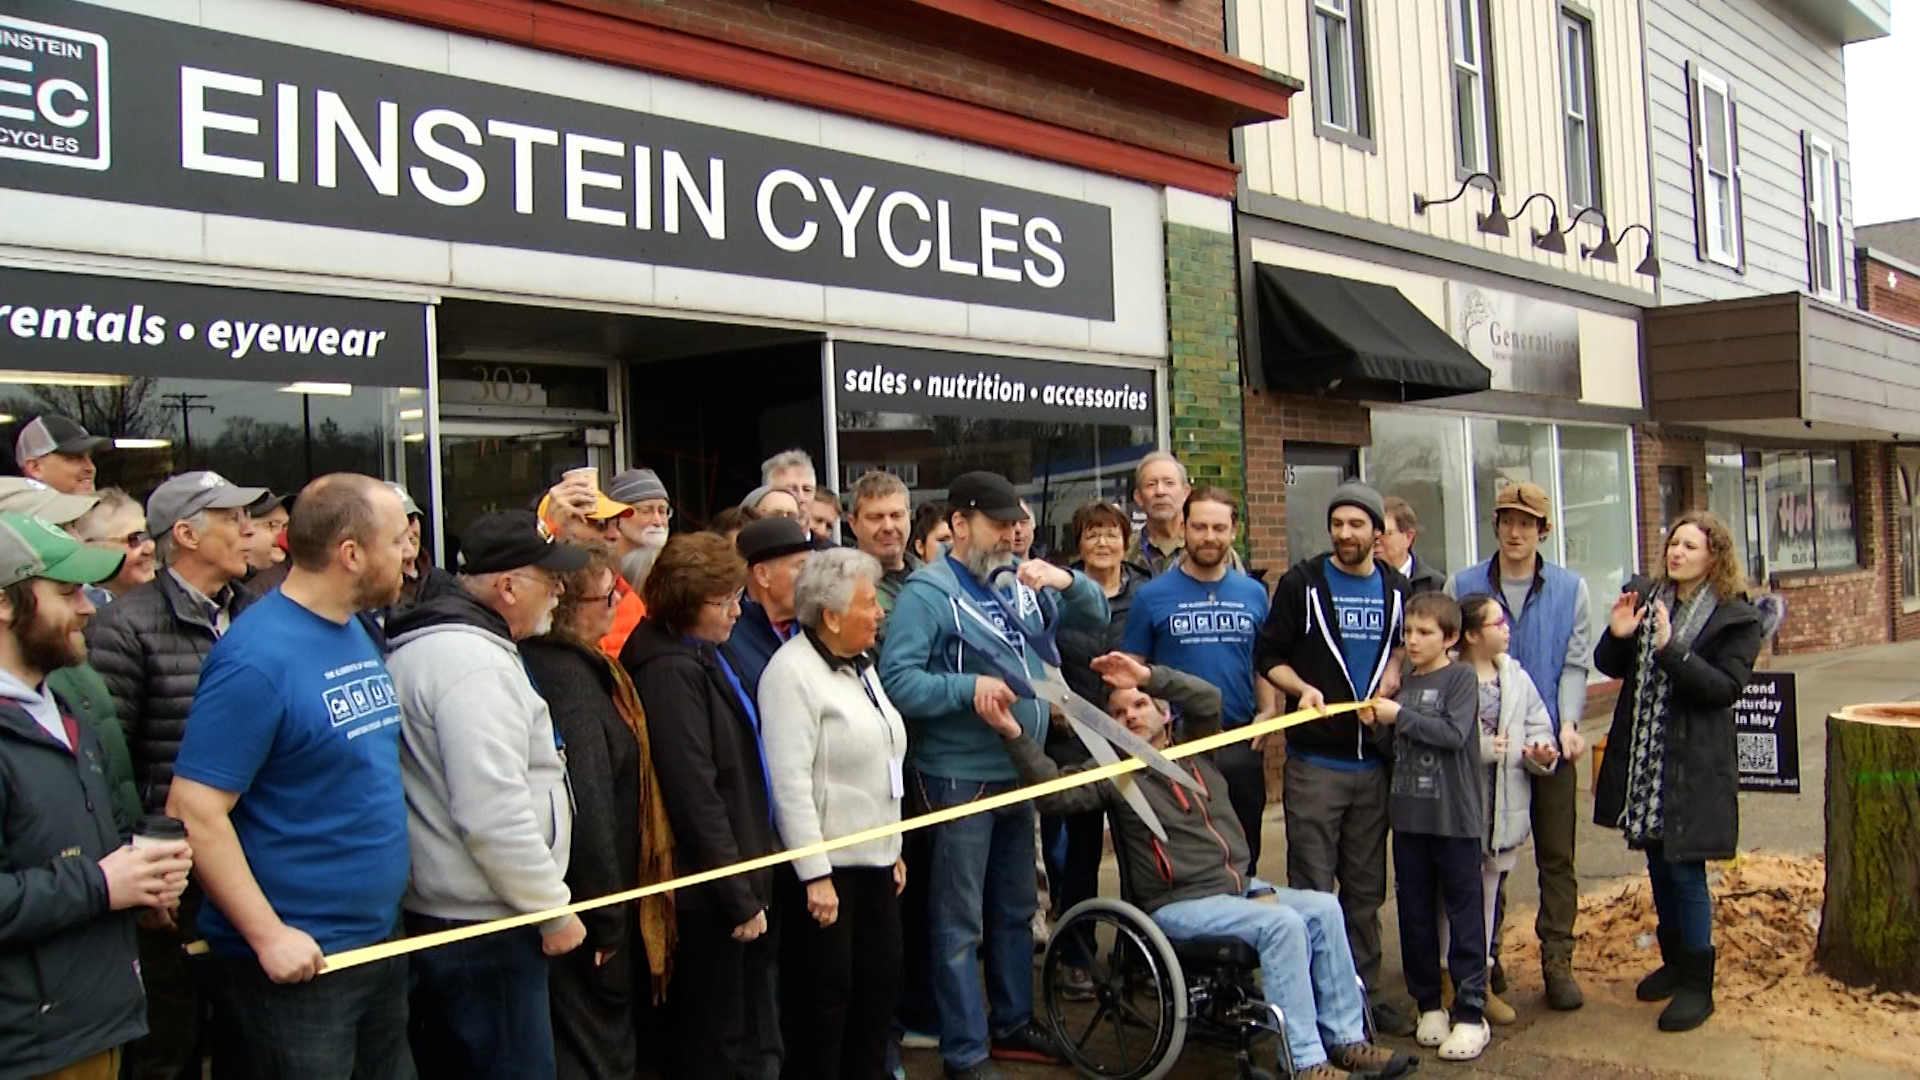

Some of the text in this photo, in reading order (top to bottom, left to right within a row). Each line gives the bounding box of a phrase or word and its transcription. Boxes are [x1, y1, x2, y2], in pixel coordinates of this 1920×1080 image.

[181, 65, 1066, 289] EINSTEIN CYCLES
[0, 304, 387, 358] rentals eyewear
[844, 365, 1149, 411] sales nutrition accessories
[1742, 681, 1776, 694] cond
[1732, 697, 1782, 714] aturday
[1749, 713, 1777, 729] May
